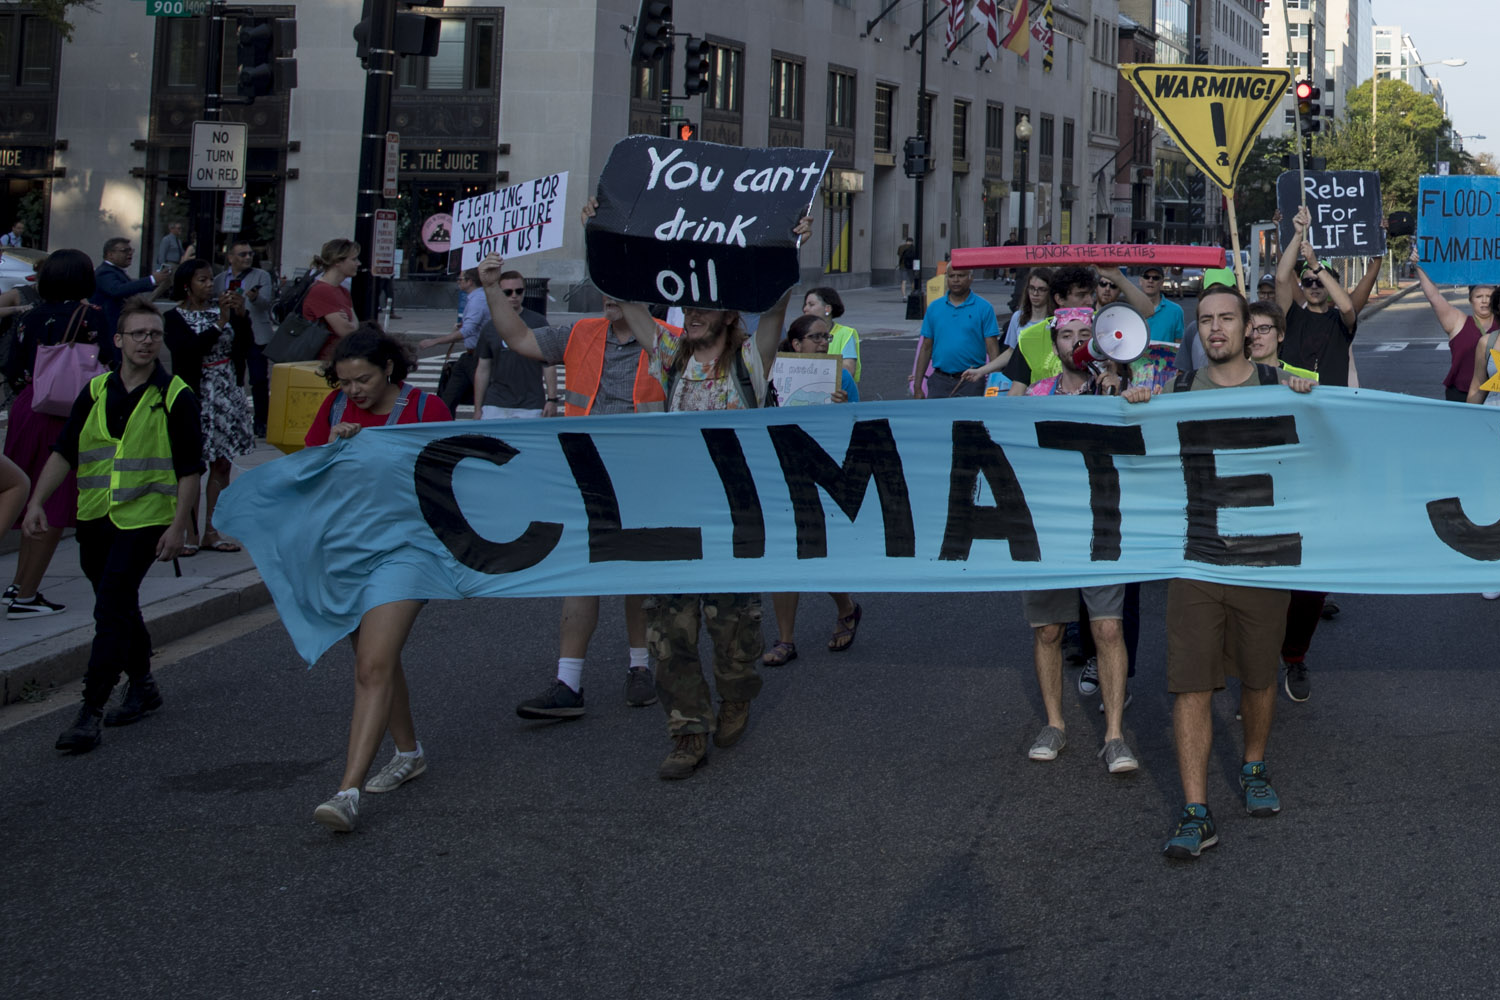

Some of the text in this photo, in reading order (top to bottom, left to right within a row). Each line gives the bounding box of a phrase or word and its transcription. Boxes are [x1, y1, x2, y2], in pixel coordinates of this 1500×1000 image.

[154, 1, 182, 14] 900
[1155, 75, 1276, 101] WARMING!
[212, 131, 229, 144] NO
[206, 150, 234, 162] TURN
[418, 153, 442, 169] THE
[444, 153, 479, 170] JUICE
[197, 168, 239, 181] ON RED
[647, 147, 821, 192] You can't
[457, 184, 523, 222] FIGHTING
[533, 174, 560, 202] FOR
[1303, 176, 1365, 199] Rebel
[461, 216, 493, 242] YOUR
[502, 199, 555, 233] FUTURE
[1317, 204, 1358, 223] For
[654, 207, 758, 248] drink
[1309, 223, 1368, 249] LIFE
[476, 234, 510, 262] JOIN
[1025, 246, 1156, 260] HONOR THE TREATIES
[656, 259, 718, 302] oil
[413, 415, 1303, 575] CLIMATE
